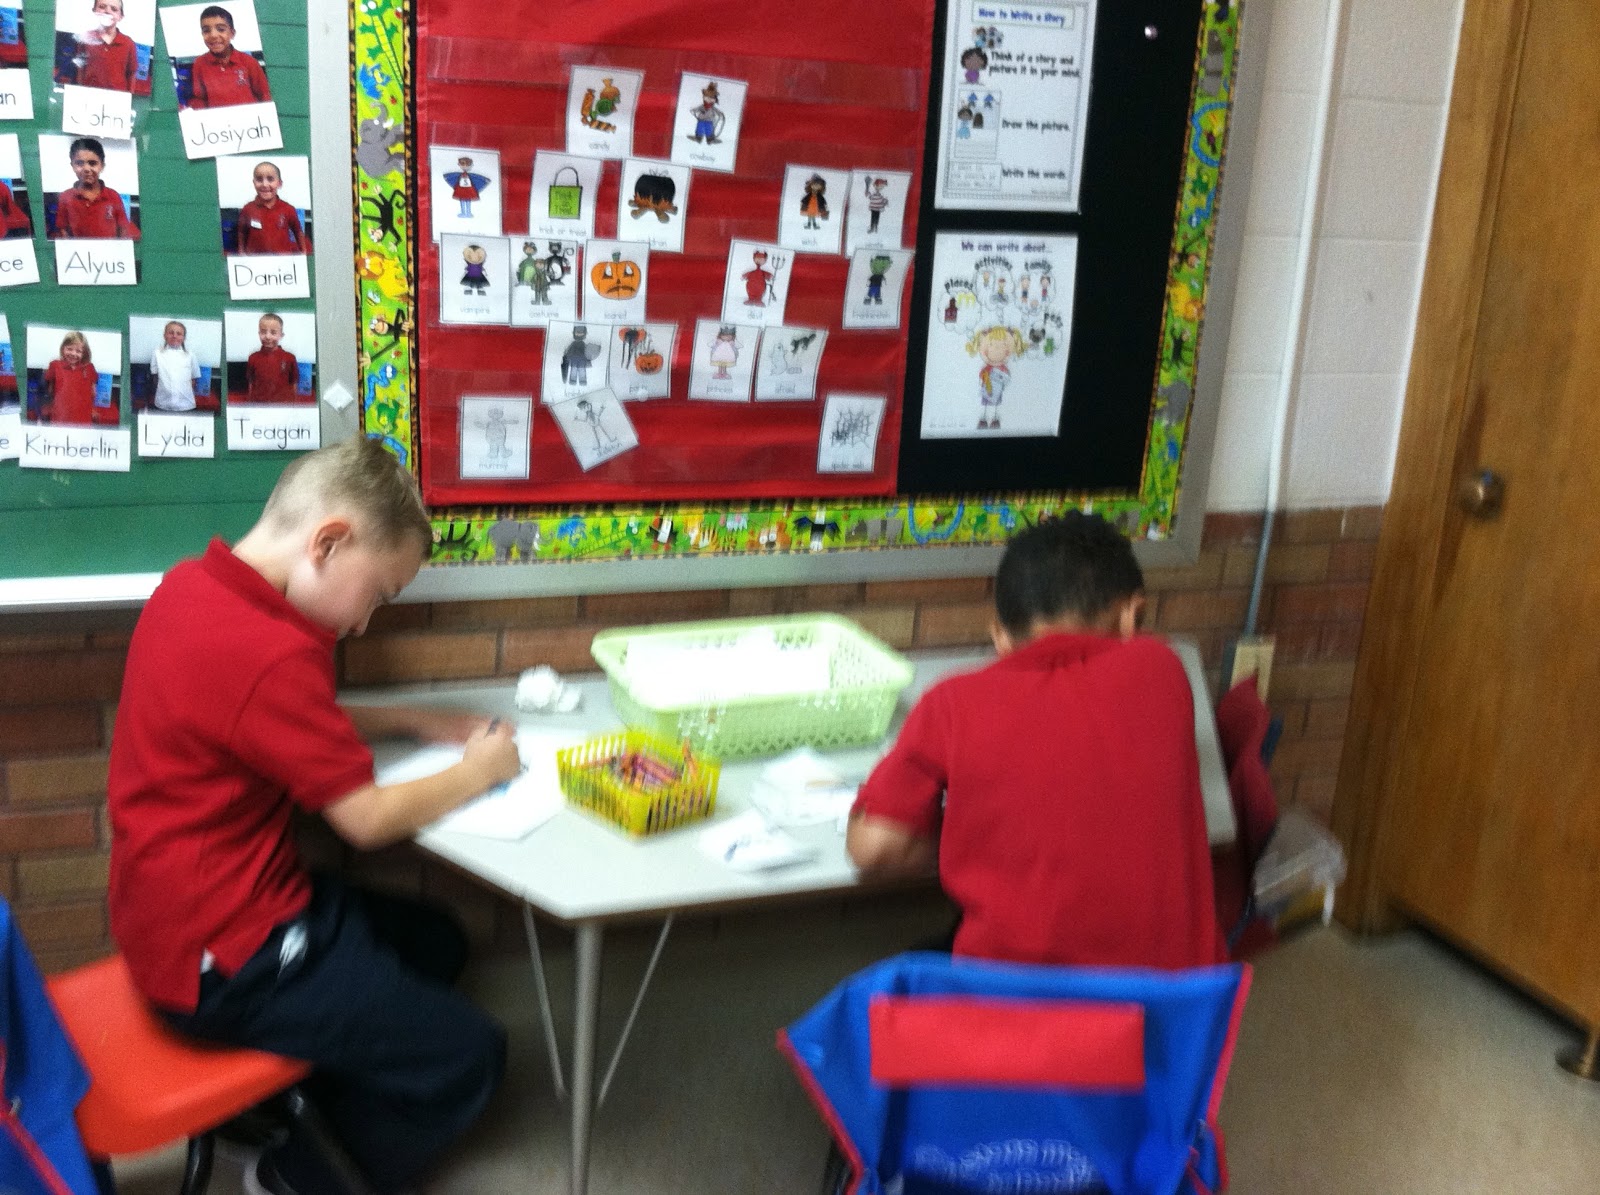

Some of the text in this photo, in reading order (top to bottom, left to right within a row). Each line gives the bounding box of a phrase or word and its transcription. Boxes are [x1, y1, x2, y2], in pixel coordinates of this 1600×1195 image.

[190, 116, 272, 152] Josiyah
[64, 252, 126, 284] Alyus
[234, 263, 298, 289] Daniel
[25, 433, 119, 459] Kimberlin
[144, 423, 205, 456] Lydia
[233, 418, 311, 450] Teagan
